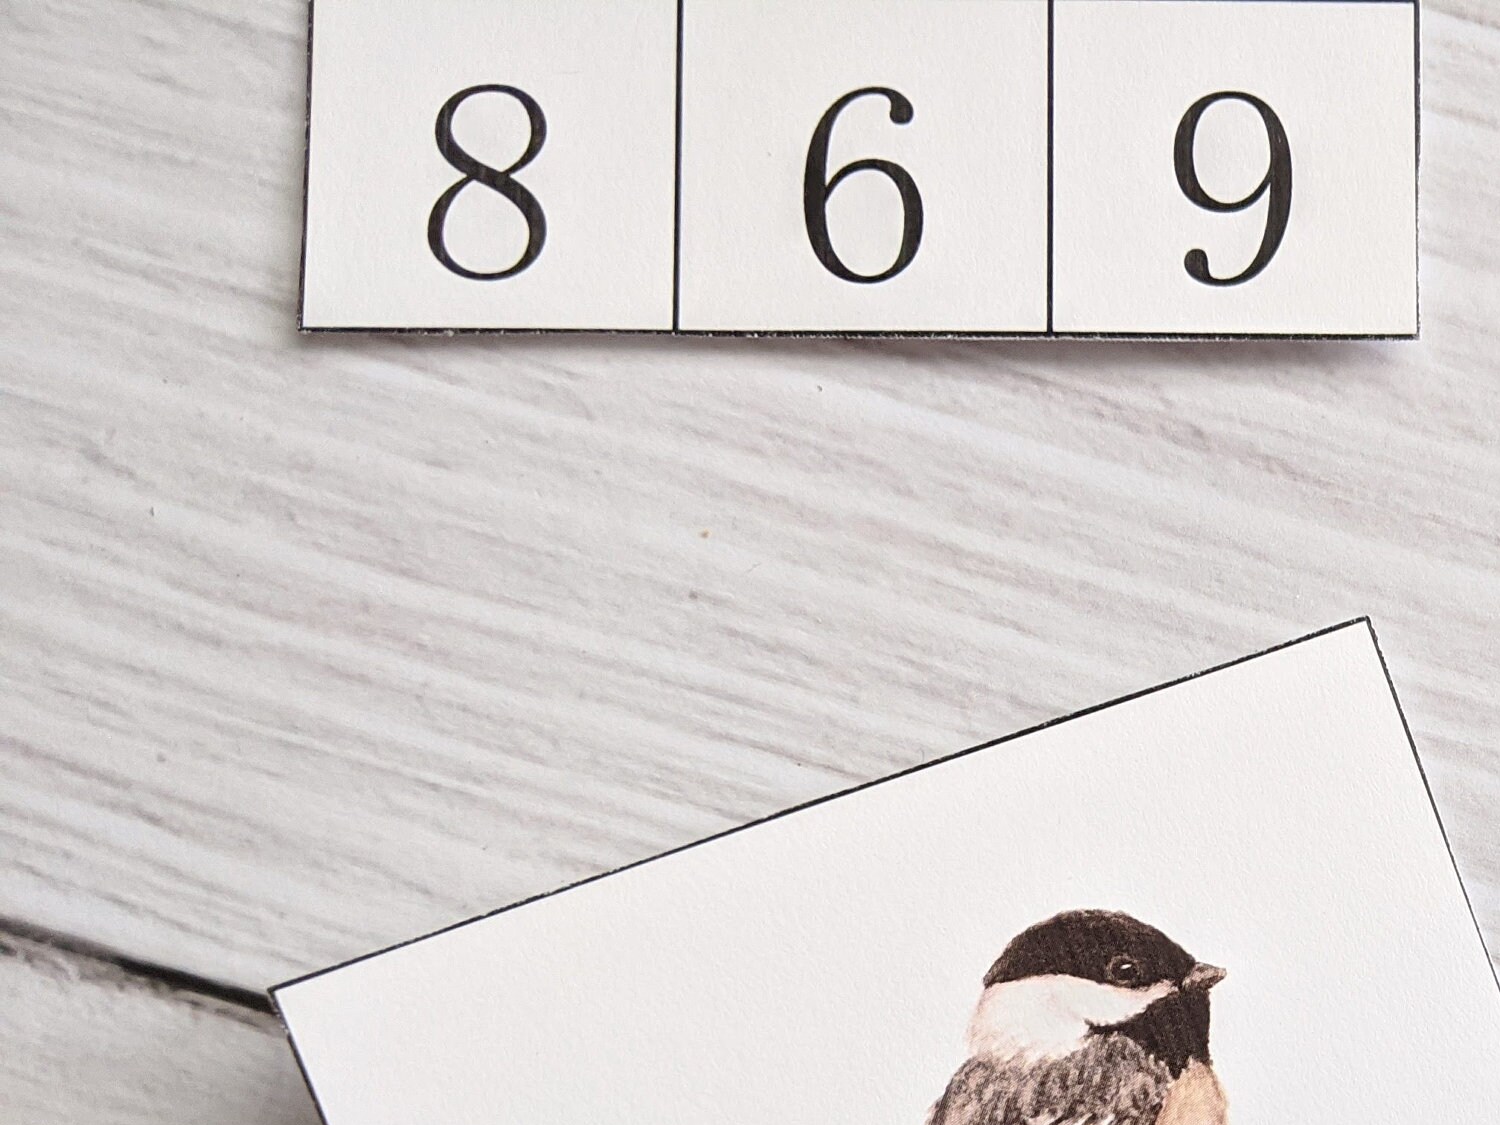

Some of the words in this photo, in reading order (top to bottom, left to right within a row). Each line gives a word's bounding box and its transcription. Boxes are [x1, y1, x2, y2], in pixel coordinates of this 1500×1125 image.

[426, 84, 548, 281] 8
[802, 86, 925, 284] 6
[1172, 90, 1294, 287] 9
